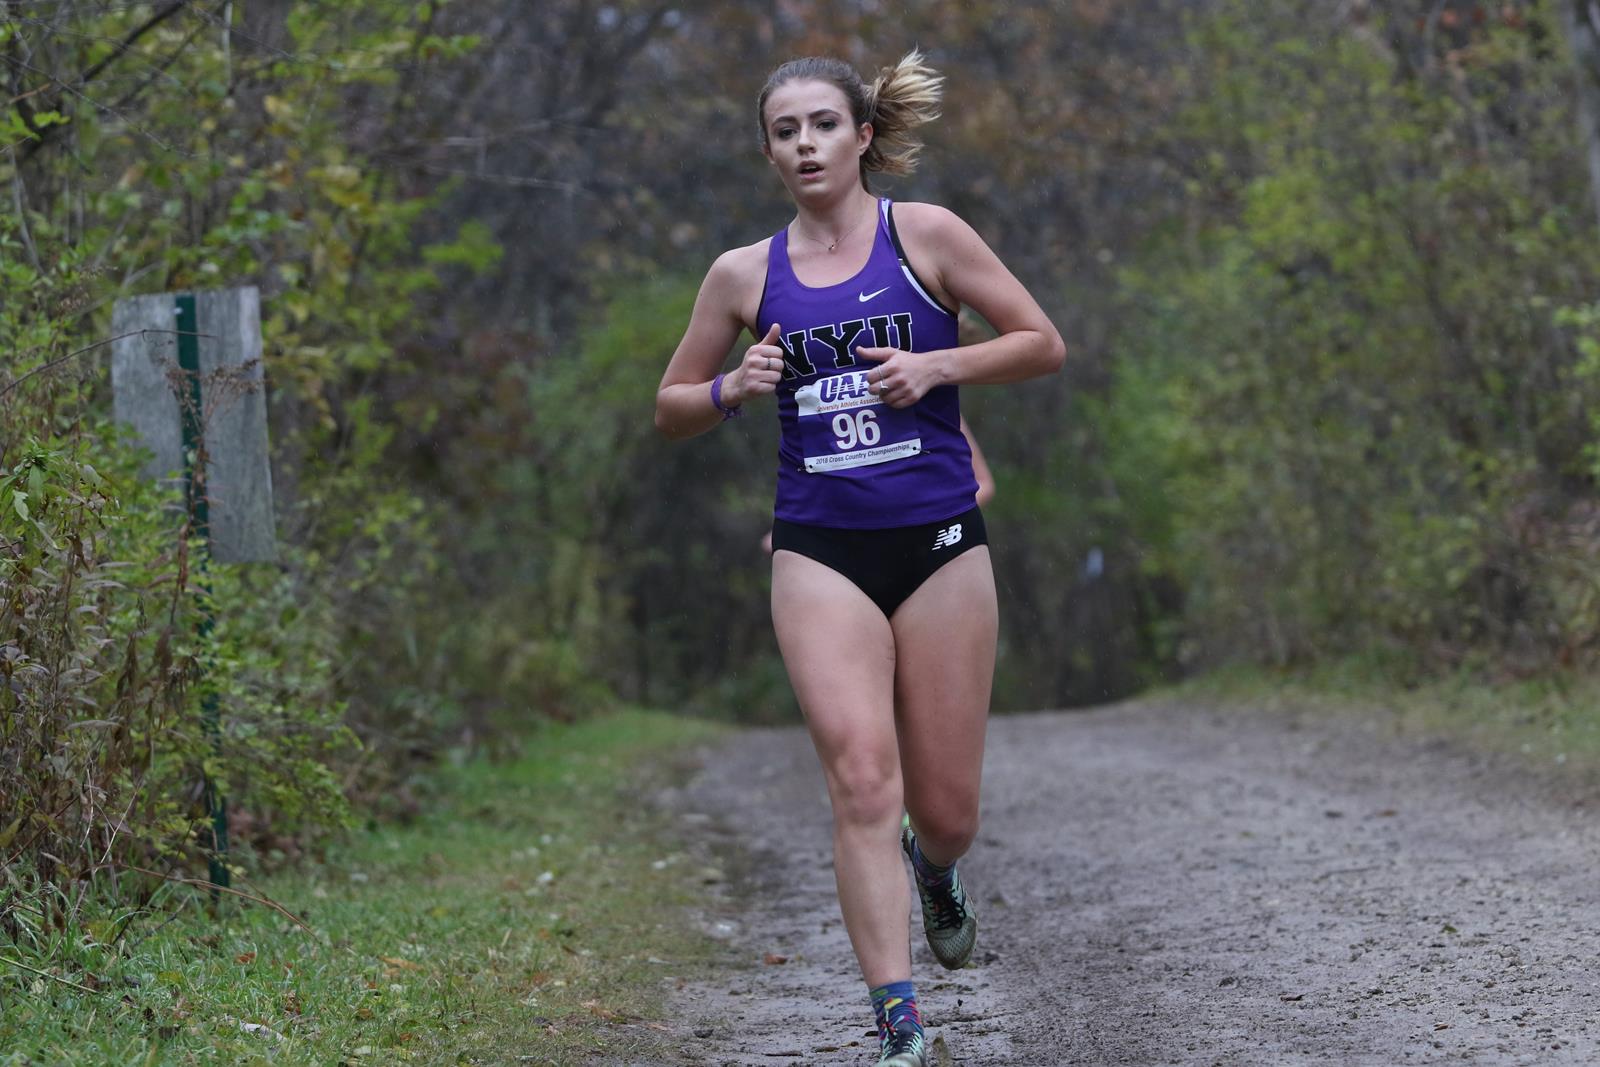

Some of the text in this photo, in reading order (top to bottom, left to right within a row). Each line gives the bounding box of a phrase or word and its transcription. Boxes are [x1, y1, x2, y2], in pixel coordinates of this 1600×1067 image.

[778, 312, 913, 381] NYU
[840, 400, 859, 408] Athletic
[832, 409, 881, 450] 96
[815, 457, 828, 465] 2018
[845, 452, 867, 461] Country
[867, 443, 910, 457] Championships
